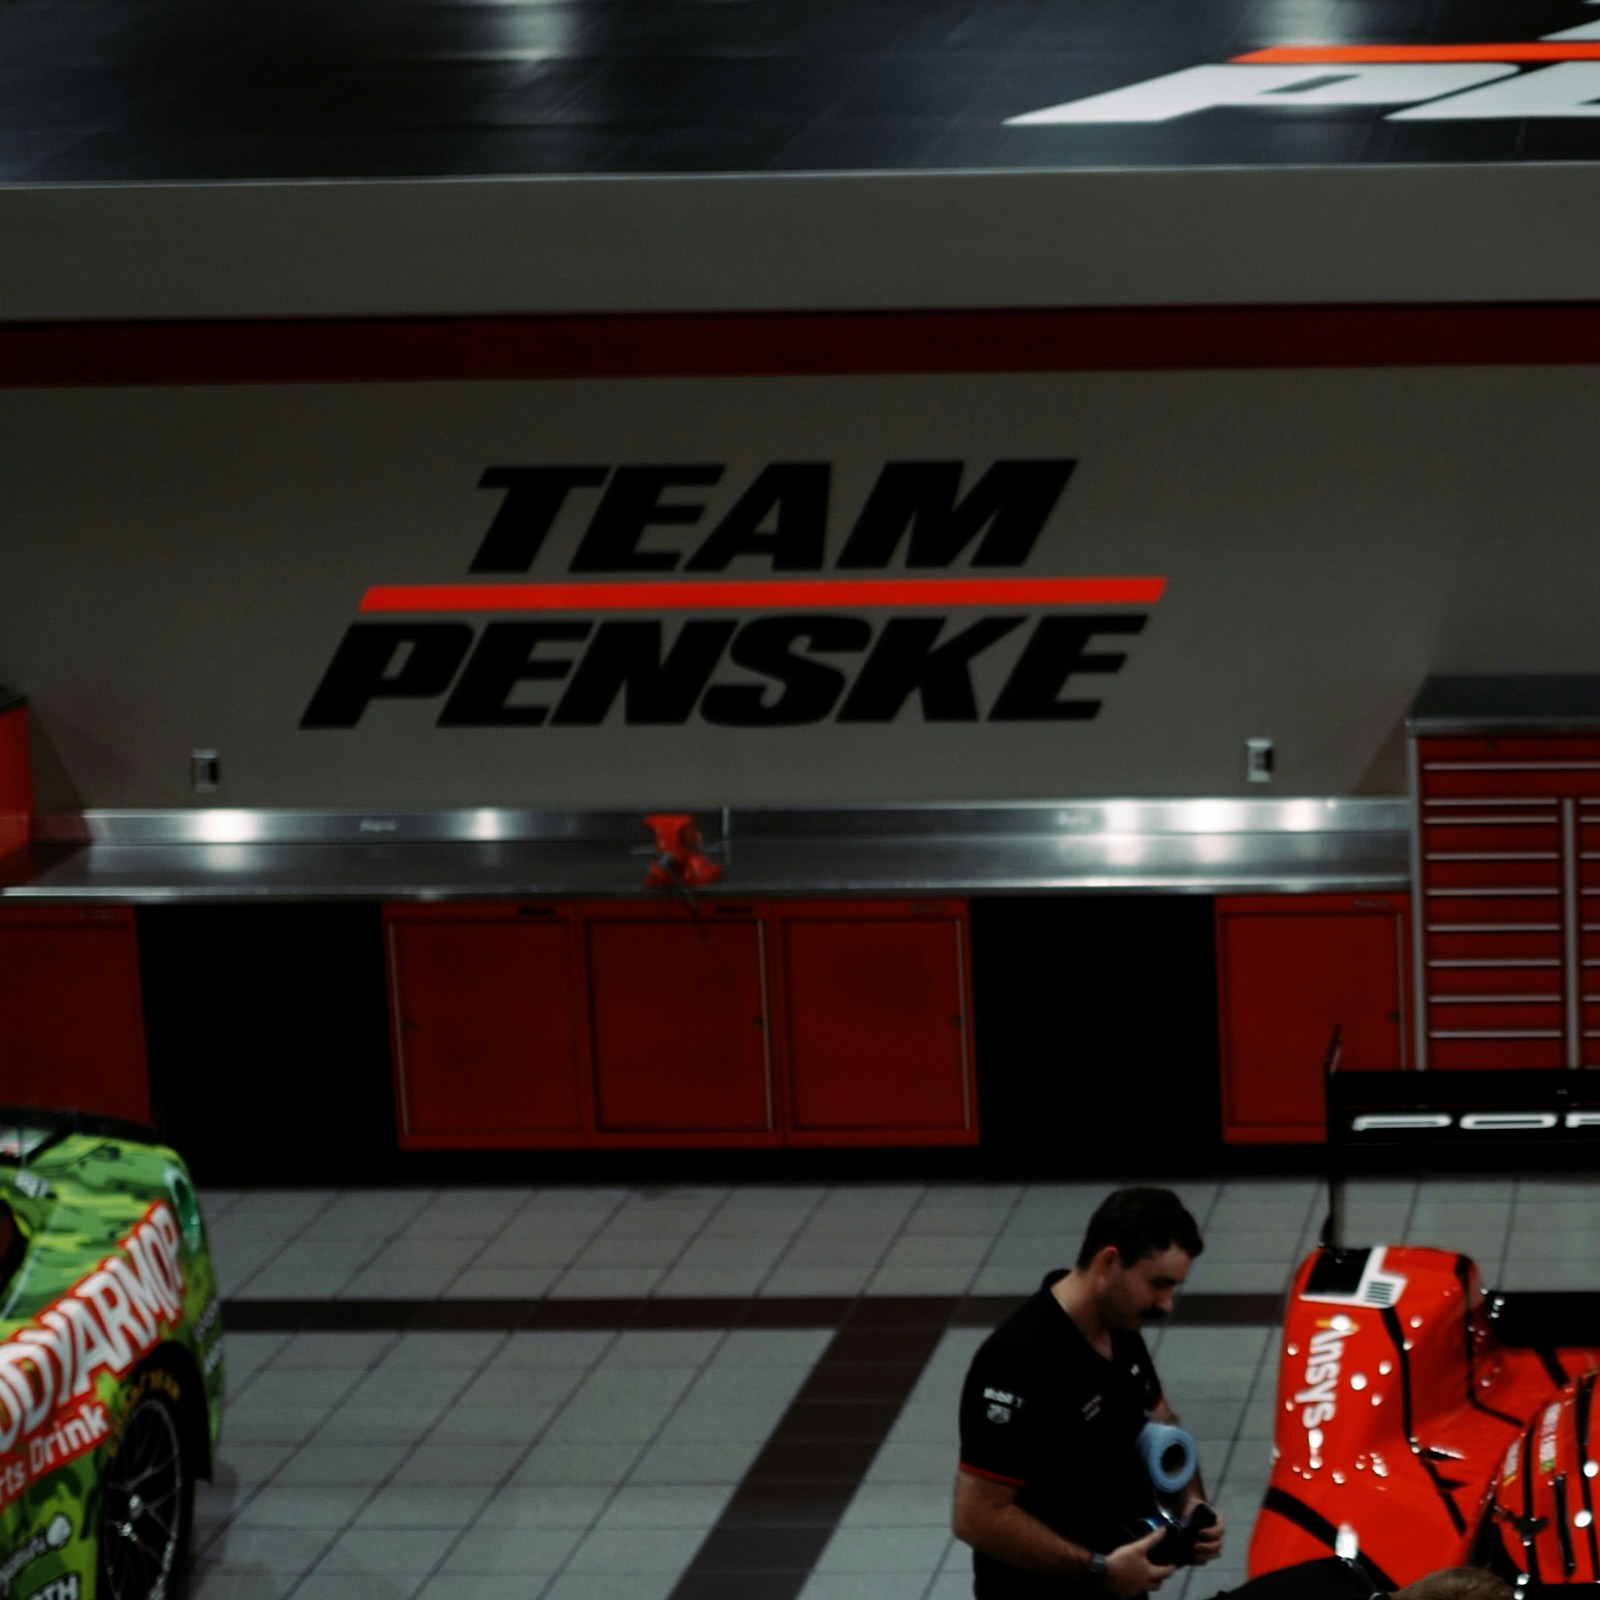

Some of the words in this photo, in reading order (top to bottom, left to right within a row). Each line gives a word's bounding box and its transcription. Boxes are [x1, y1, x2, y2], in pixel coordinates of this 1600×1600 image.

[468, 458, 1079, 573] TEAM
[298, 613, 1148, 730] PENSKE
[1294, 1312, 1361, 1430] Ansys
[30, 1402, 109, 1475] Drink
